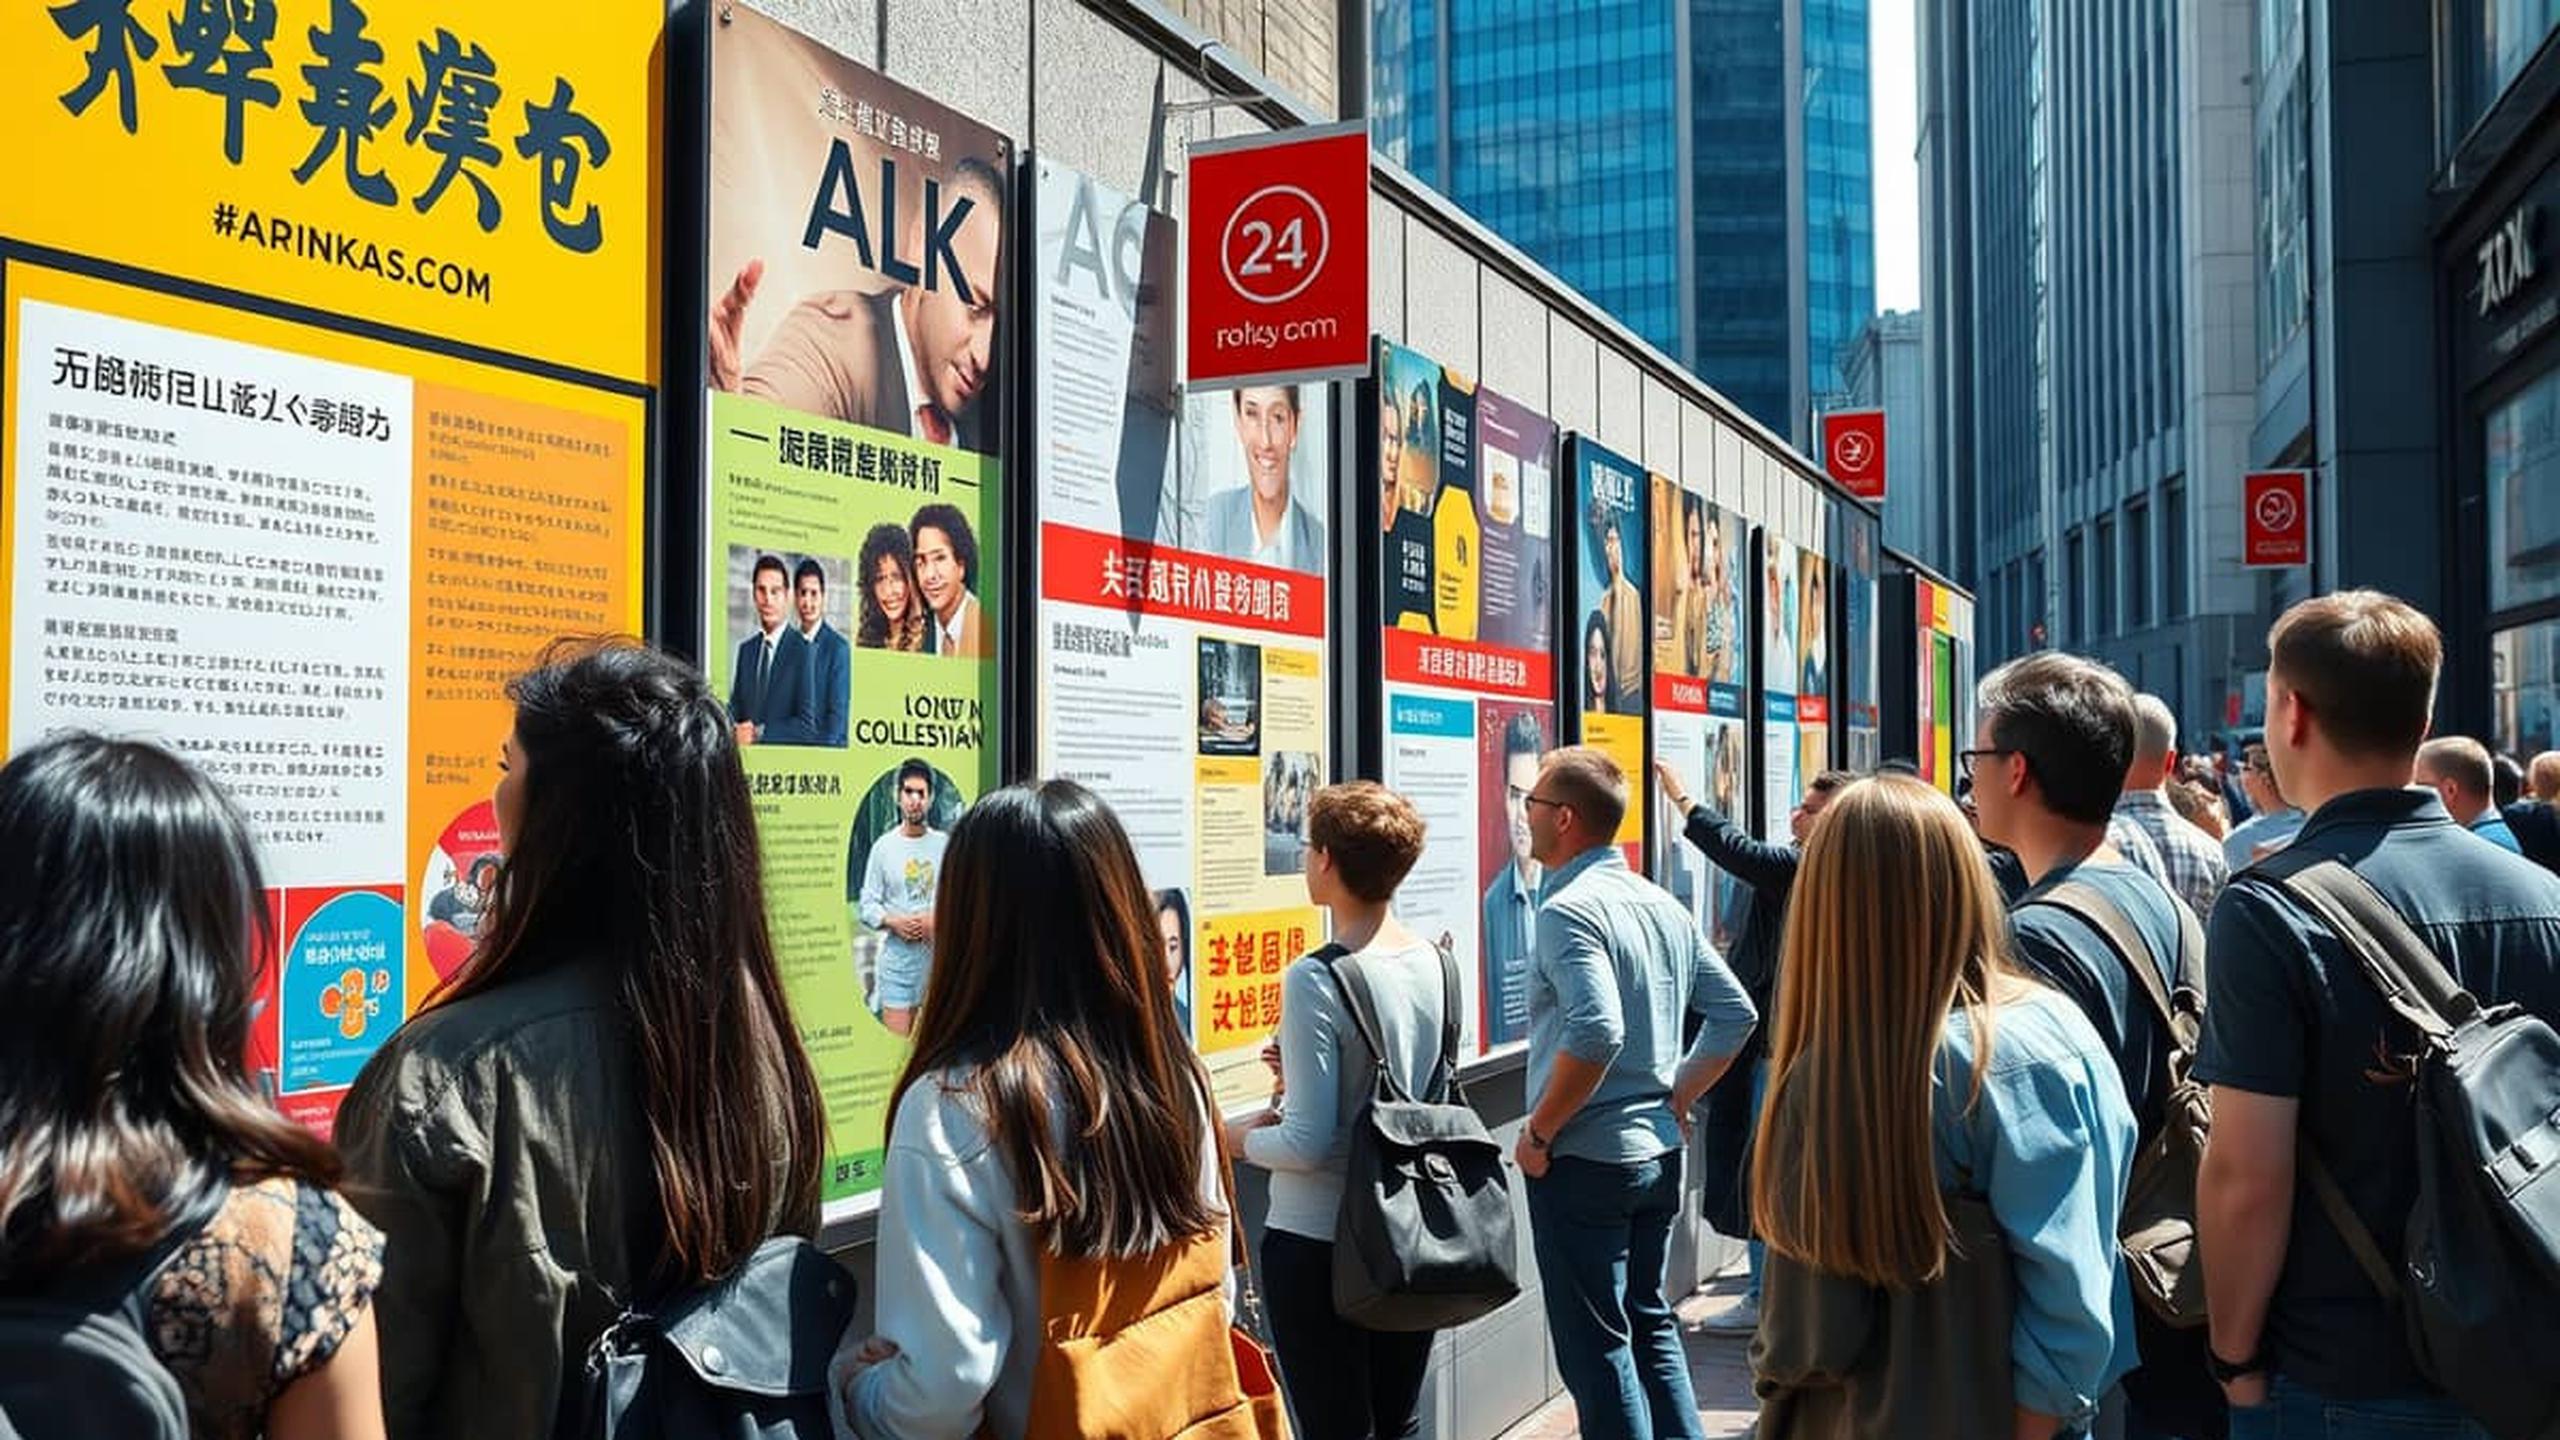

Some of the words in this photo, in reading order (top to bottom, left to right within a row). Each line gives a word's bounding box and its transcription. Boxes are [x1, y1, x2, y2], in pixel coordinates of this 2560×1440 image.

[212, 202, 492, 304] #ARINKAS.COM
[802, 137, 978, 303] ALK
[1239, 217, 1308, 277] 24
